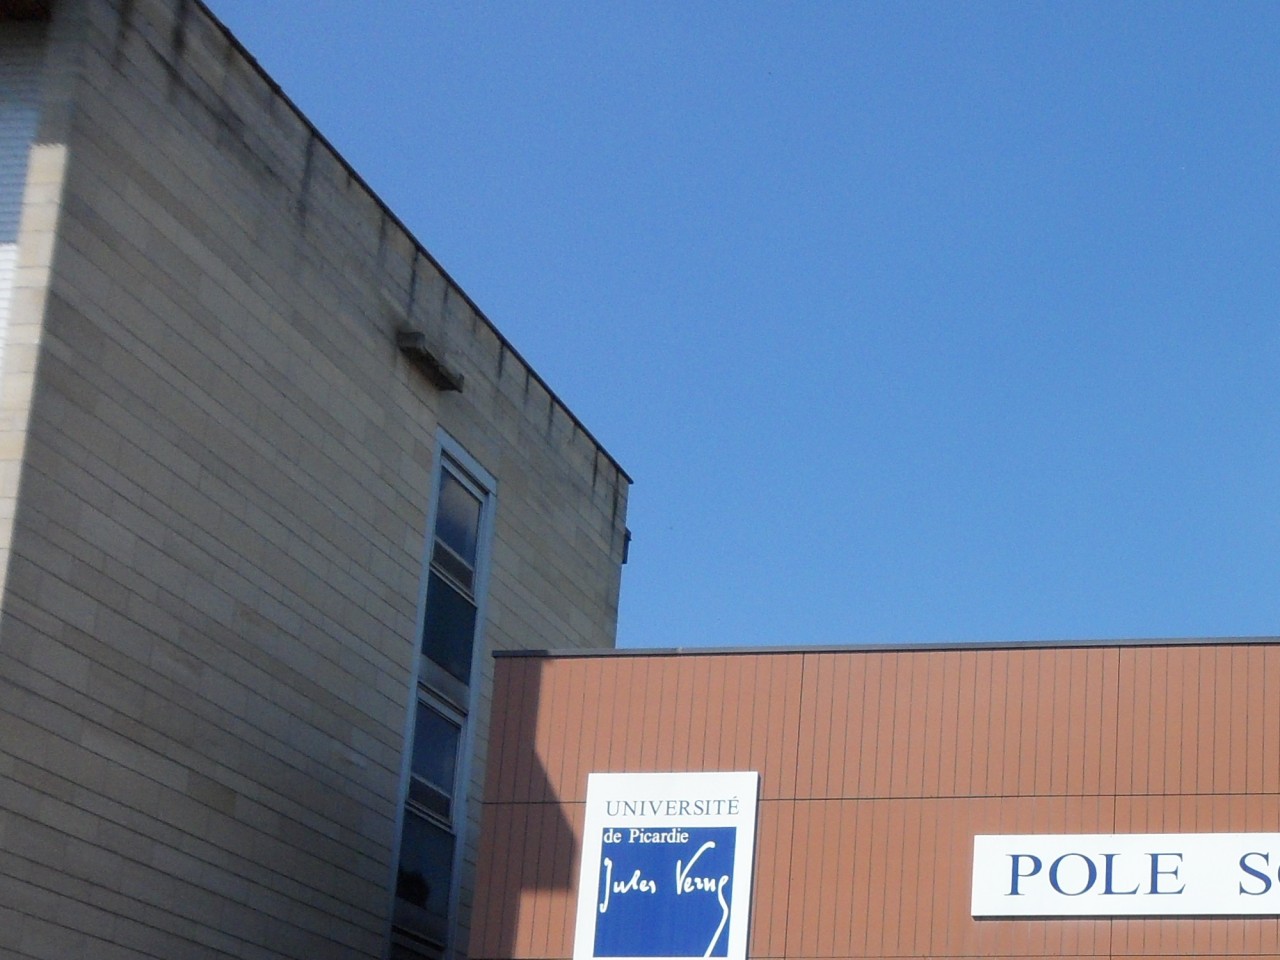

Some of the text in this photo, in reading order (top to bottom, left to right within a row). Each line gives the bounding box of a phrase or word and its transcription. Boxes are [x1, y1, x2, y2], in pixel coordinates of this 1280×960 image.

[606, 796, 739, 816] UNIVERSITÉ
[604, 828, 689, 843] de Picardie
[1003, 852, 1187, 897] POLE
[600, 841, 729, 957] Jules Verne
